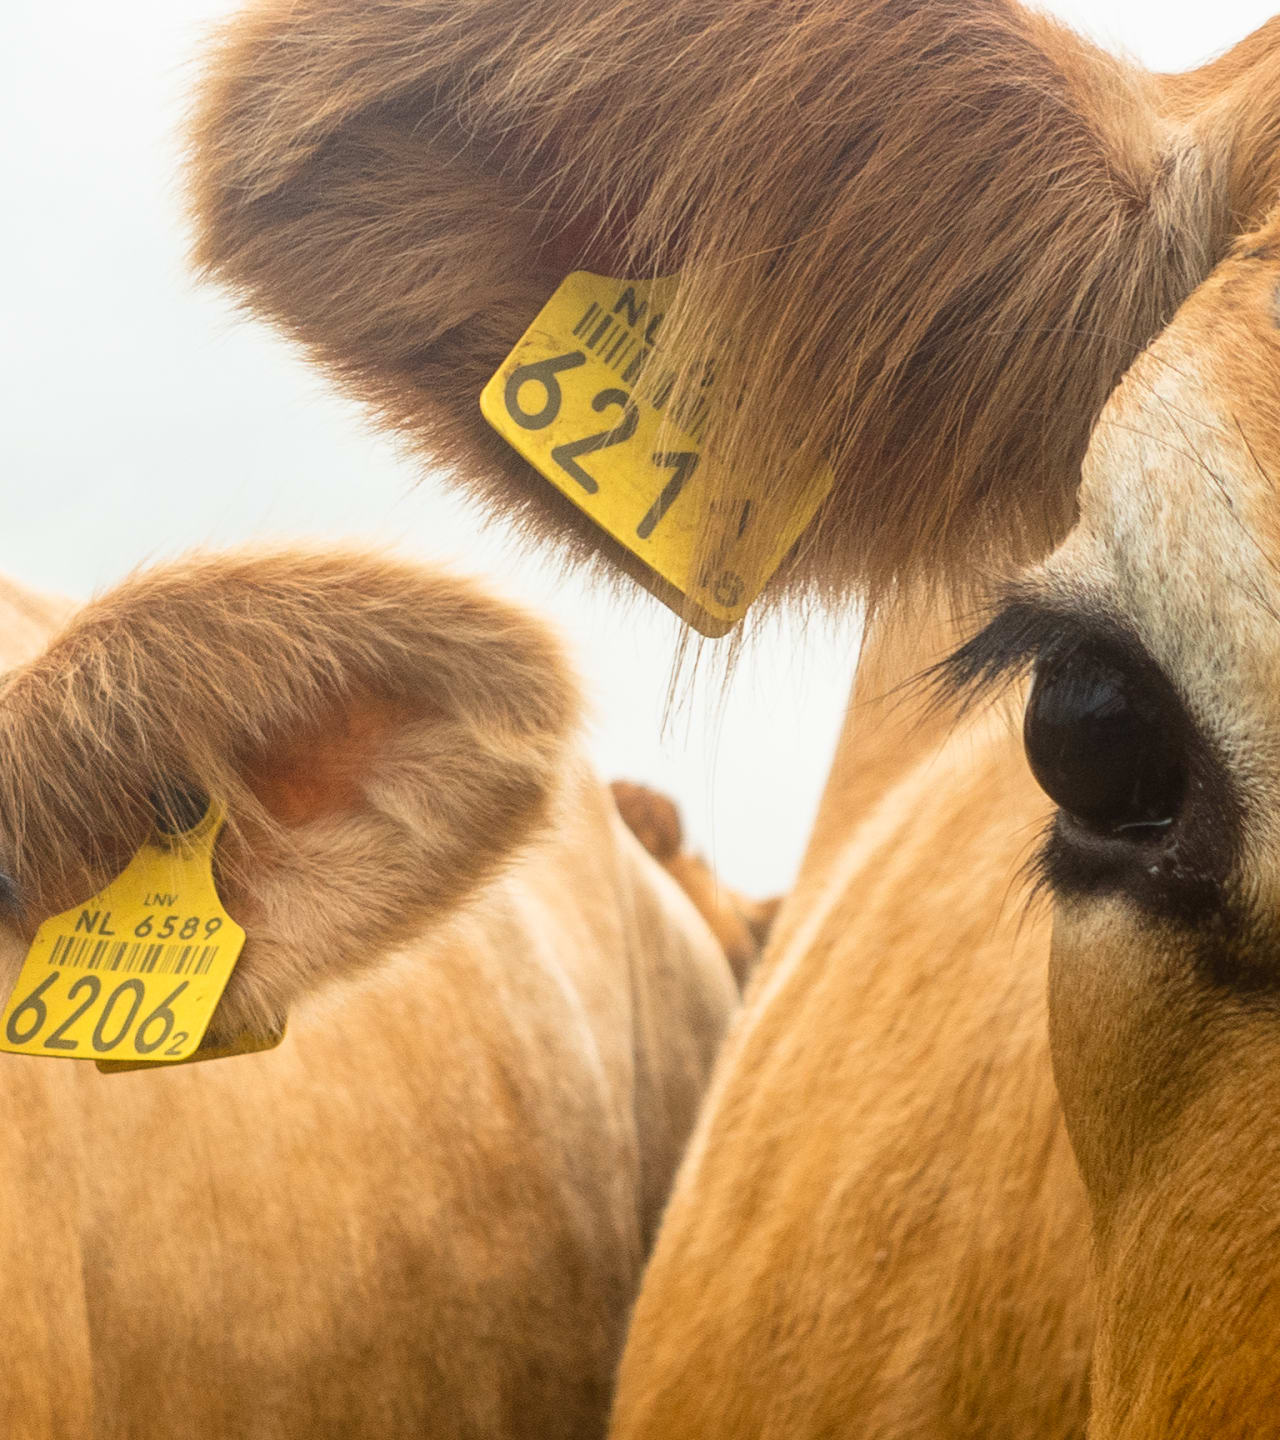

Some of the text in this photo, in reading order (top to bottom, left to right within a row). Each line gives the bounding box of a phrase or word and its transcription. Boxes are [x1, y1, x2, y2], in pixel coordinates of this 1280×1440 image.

[143, 893, 178, 907] LNV
[75, 910, 223, 941] NL 6589
